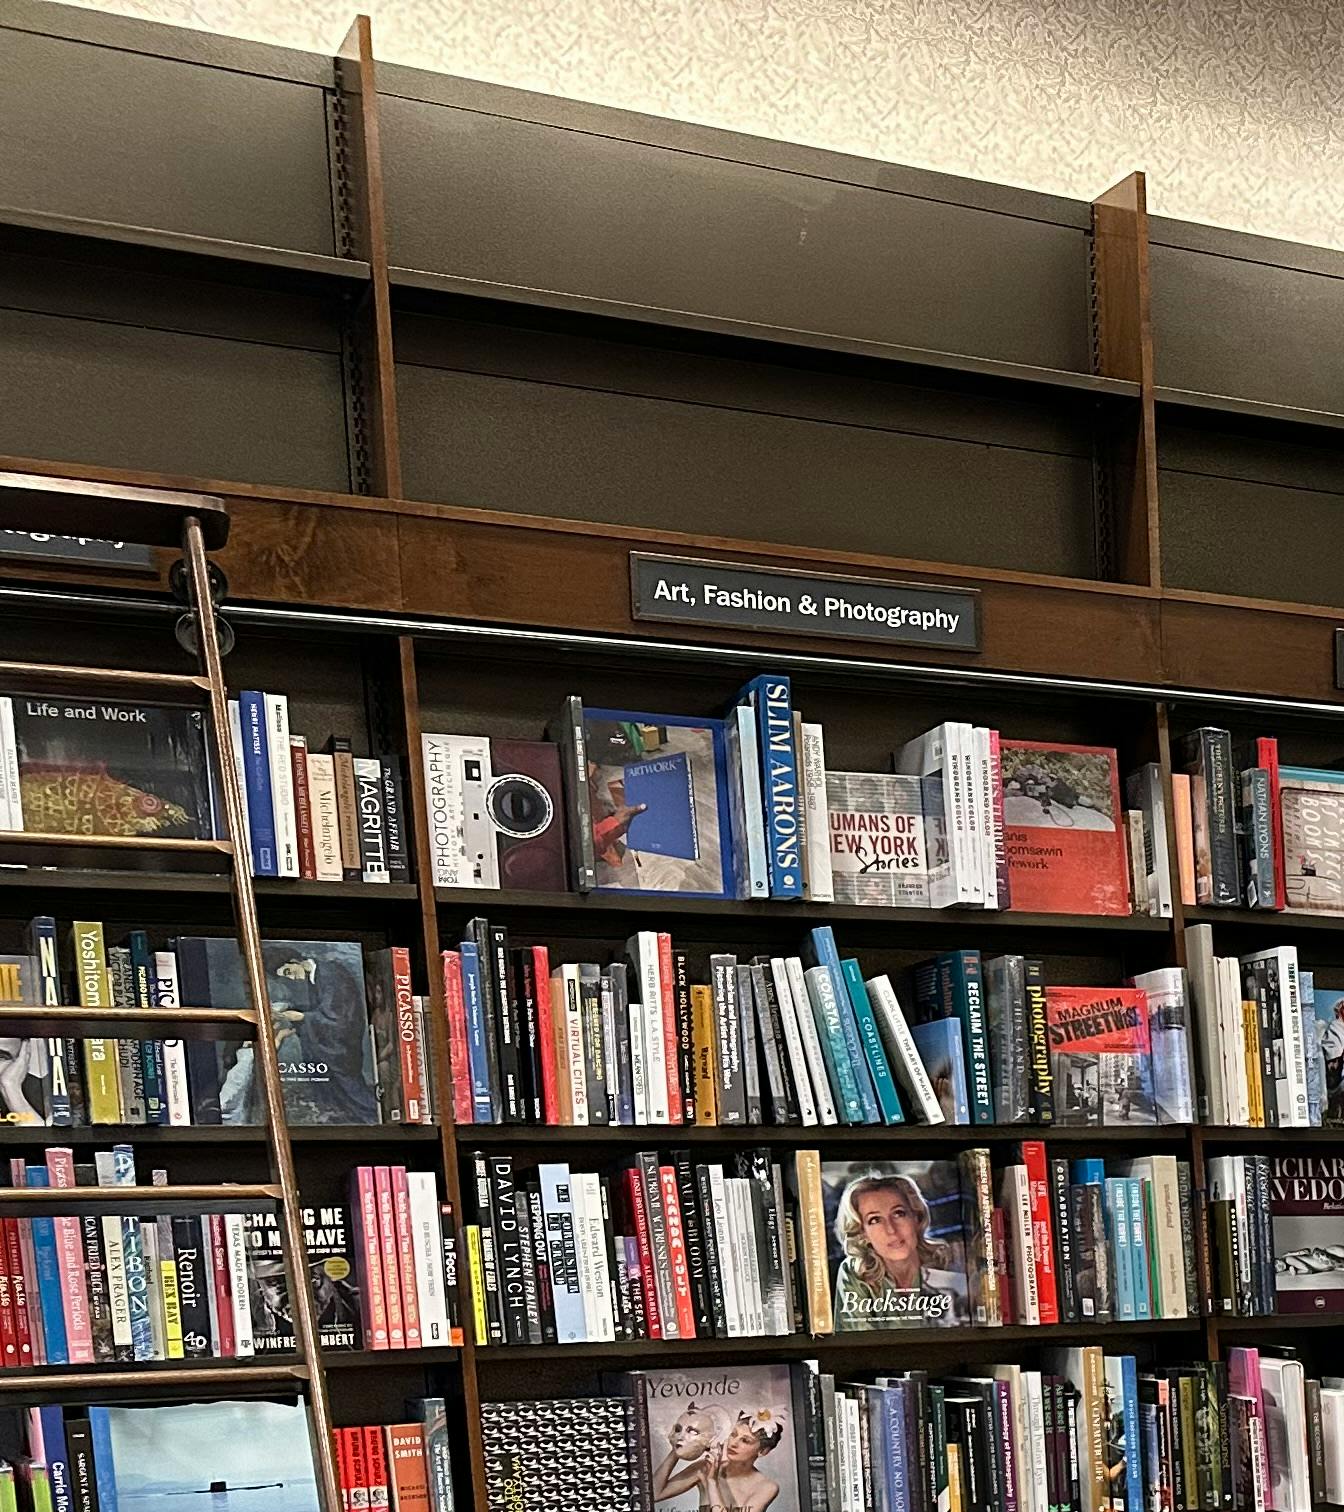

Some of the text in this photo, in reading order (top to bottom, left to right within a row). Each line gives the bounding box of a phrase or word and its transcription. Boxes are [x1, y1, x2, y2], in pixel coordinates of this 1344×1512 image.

[653, 580, 960, 633] Art, Fashion & Photography
[26, 702, 146, 723] Life and Work
[425, 738, 446, 868] PHOTOGRAPHY
[766, 682, 799, 870] SLIM AARONS
[354, 758, 384, 877] MAGRITTE
[396, 973, 414, 1043] PICASSO
[1025, 985, 1052, 1099] photography
[1056, 997, 1124, 1021] MAGNUM
[569, 1018, 584, 1105] VIRTUAL CITIES
[861, 1016, 887, 1079] COASTLINES
[967, 981, 990, 1106] RECLAIM THE STREET
[495, 1161, 526, 1309] DAVID LYNCH
[178, 1246, 197, 1308] Renoir
[840, 1291, 953, 1316] Backstage
[646, 1375, 741, 1400] Yevonde
